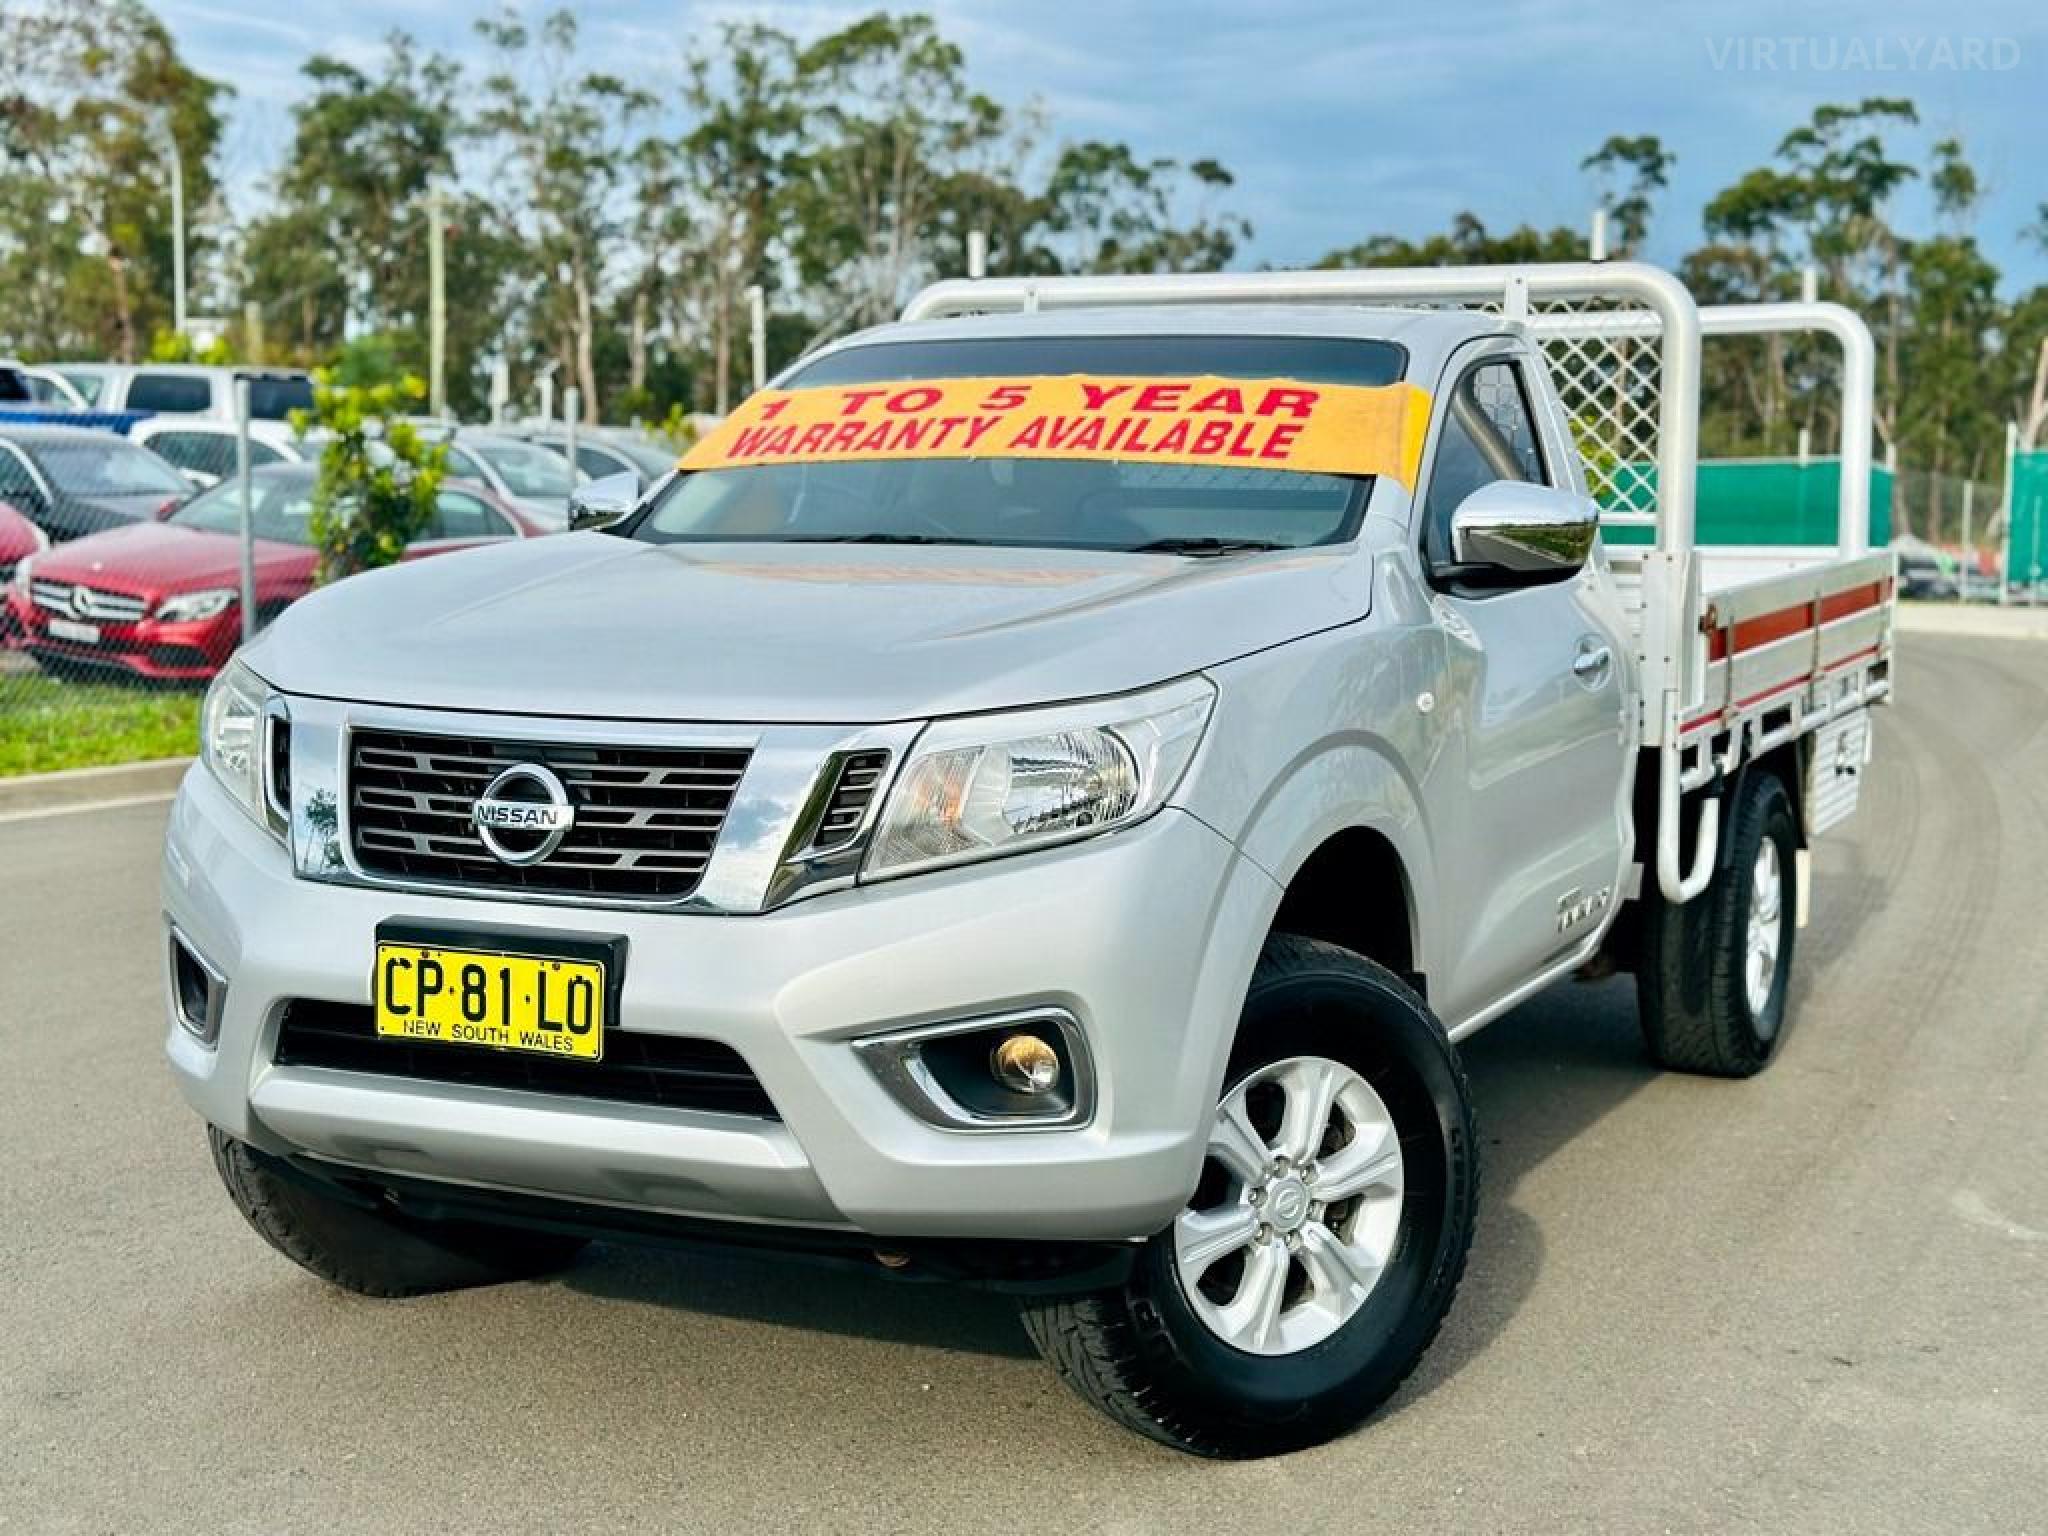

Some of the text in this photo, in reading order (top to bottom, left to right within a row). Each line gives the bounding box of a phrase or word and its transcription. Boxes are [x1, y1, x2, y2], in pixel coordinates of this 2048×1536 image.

[760, 384, 1320, 421] 1 TO 5 YEAR
[727, 415, 1305, 459] WARRANTY AVAILABLE
[477, 805, 558, 826] NISSAN
[402, 1019, 574, 1052] NEW SOUTH WALES
